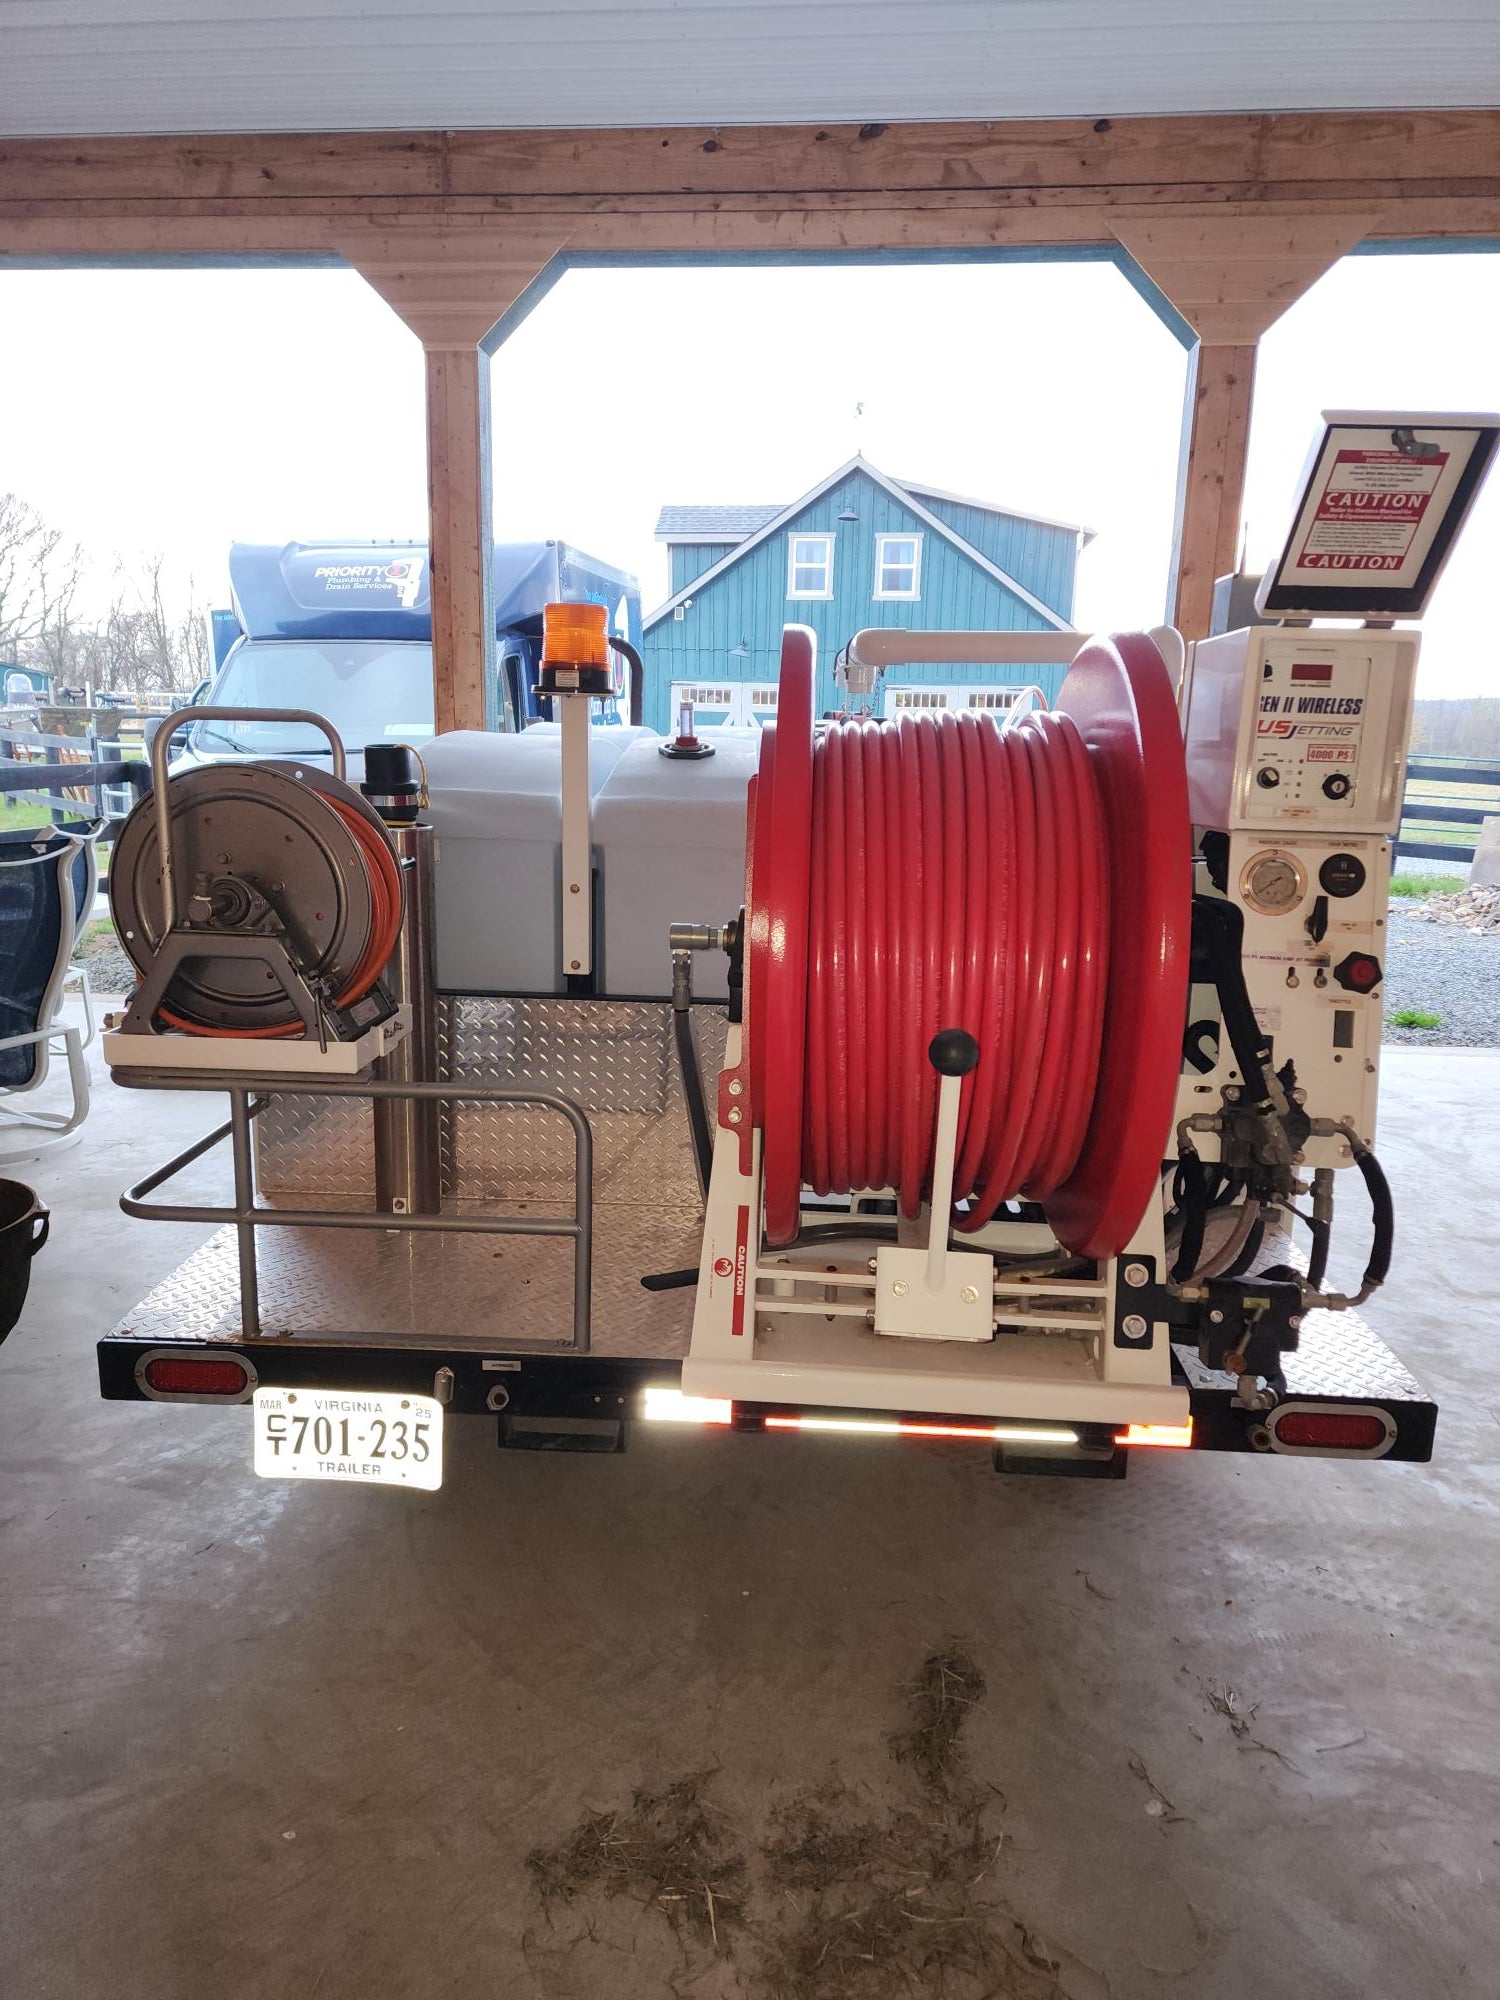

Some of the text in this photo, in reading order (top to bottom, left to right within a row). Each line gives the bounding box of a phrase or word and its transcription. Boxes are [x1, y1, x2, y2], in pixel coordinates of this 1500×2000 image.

[1325, 493, 1424, 508] CAUTION
[1303, 555, 1398, 569] CAUTION
[314, 565, 387, 578] PRIORITY
[327, 576, 371, 584] Plumbing
[353, 582, 393, 590] Services
[1297, 697, 1364, 715] WIRELESS
[1310, 750, 1334, 759] 4000
[736, 1245, 746, 1296] CAUTION
[259, 1399, 282, 1410] MAR
[314, 1399, 384, 1413] VIRGINIA
[415, 1408, 432, 1419] 25
[291, 1415, 430, 1463] 701-235
[317, 1461, 382, 1476] TRAILER
